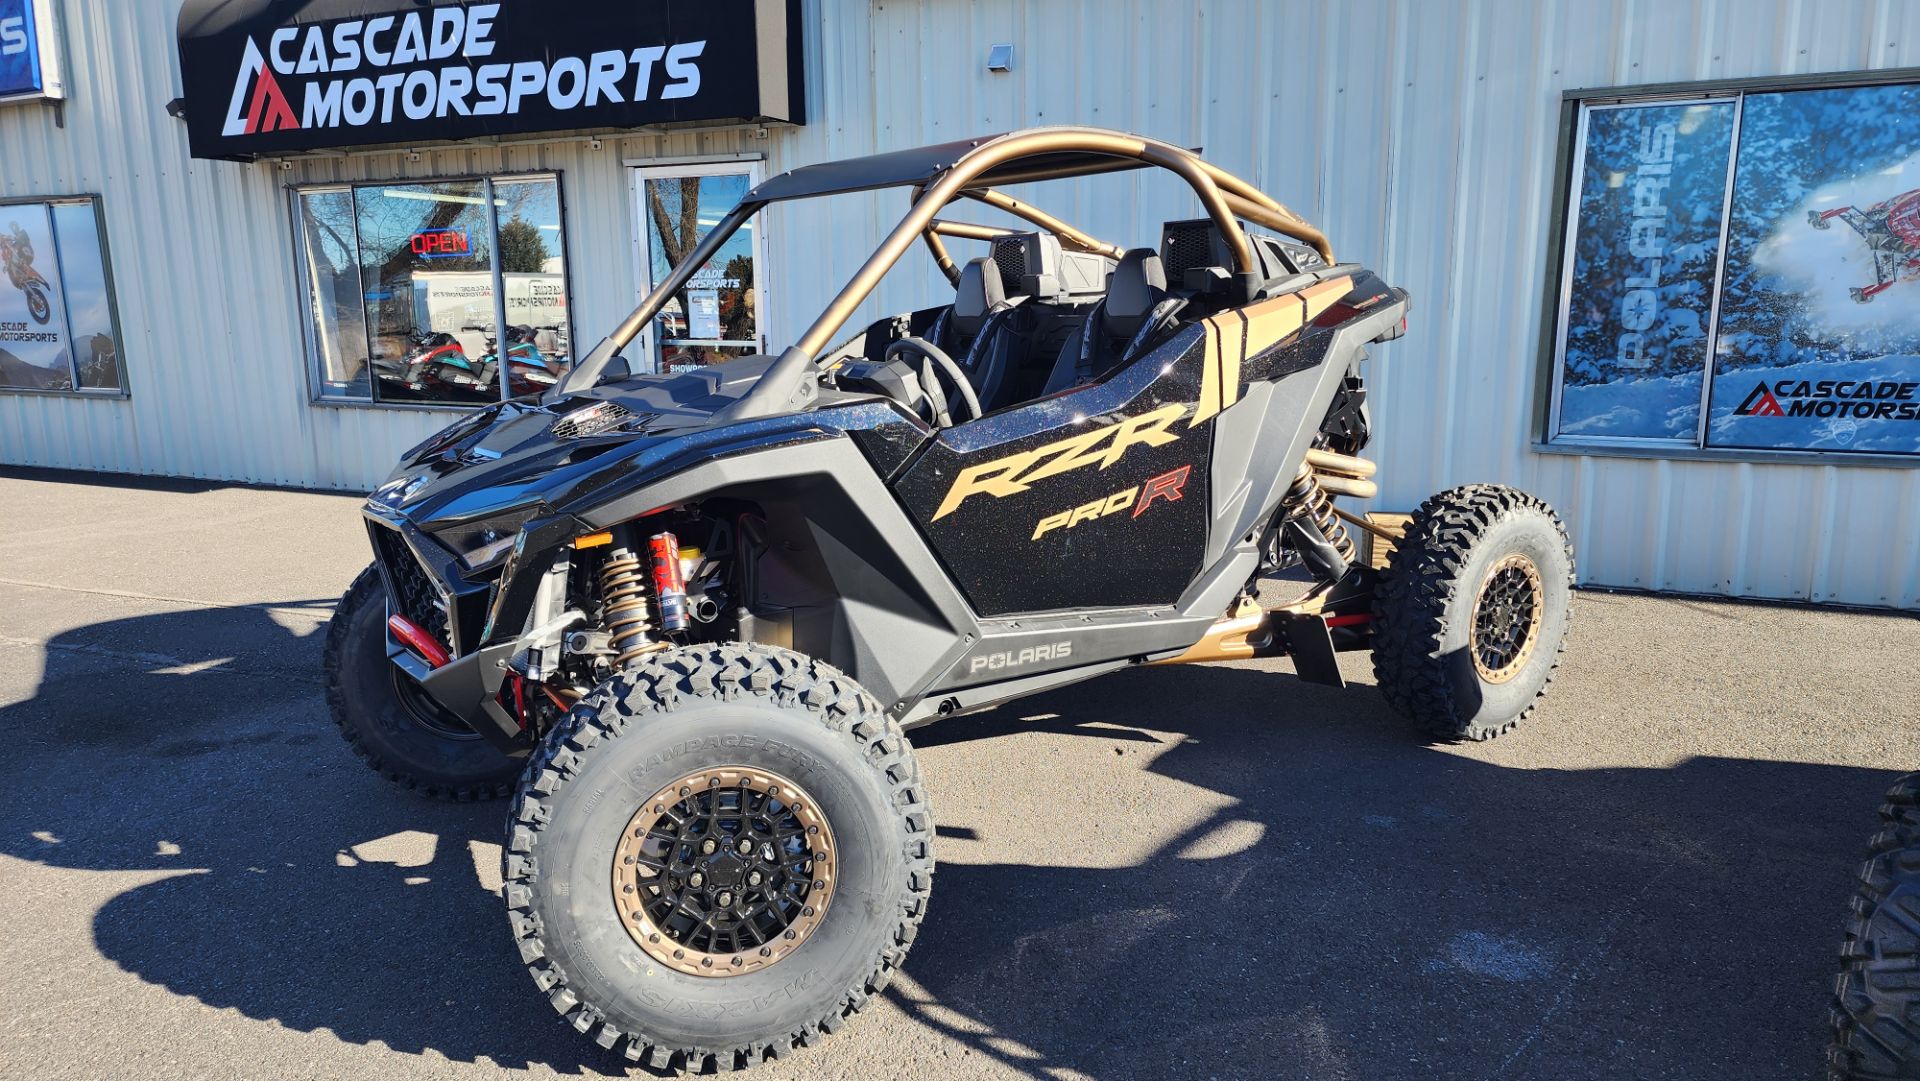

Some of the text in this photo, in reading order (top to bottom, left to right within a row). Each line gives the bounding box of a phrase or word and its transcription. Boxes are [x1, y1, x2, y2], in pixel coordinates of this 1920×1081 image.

[270, 4, 500, 75] CASCADE
[301, 40, 706, 129] MOTORSPORTS
[411, 231, 467, 254] OPEN
[1617, 123, 1676, 369] POLARIS
[1774, 380, 1920, 400] CASCADE
[1787, 400, 1920, 420] MOTORS
[931, 403, 1188, 522] RZR
[1031, 464, 1191, 541] PRO R
[970, 641, 1073, 673] POLARIS
